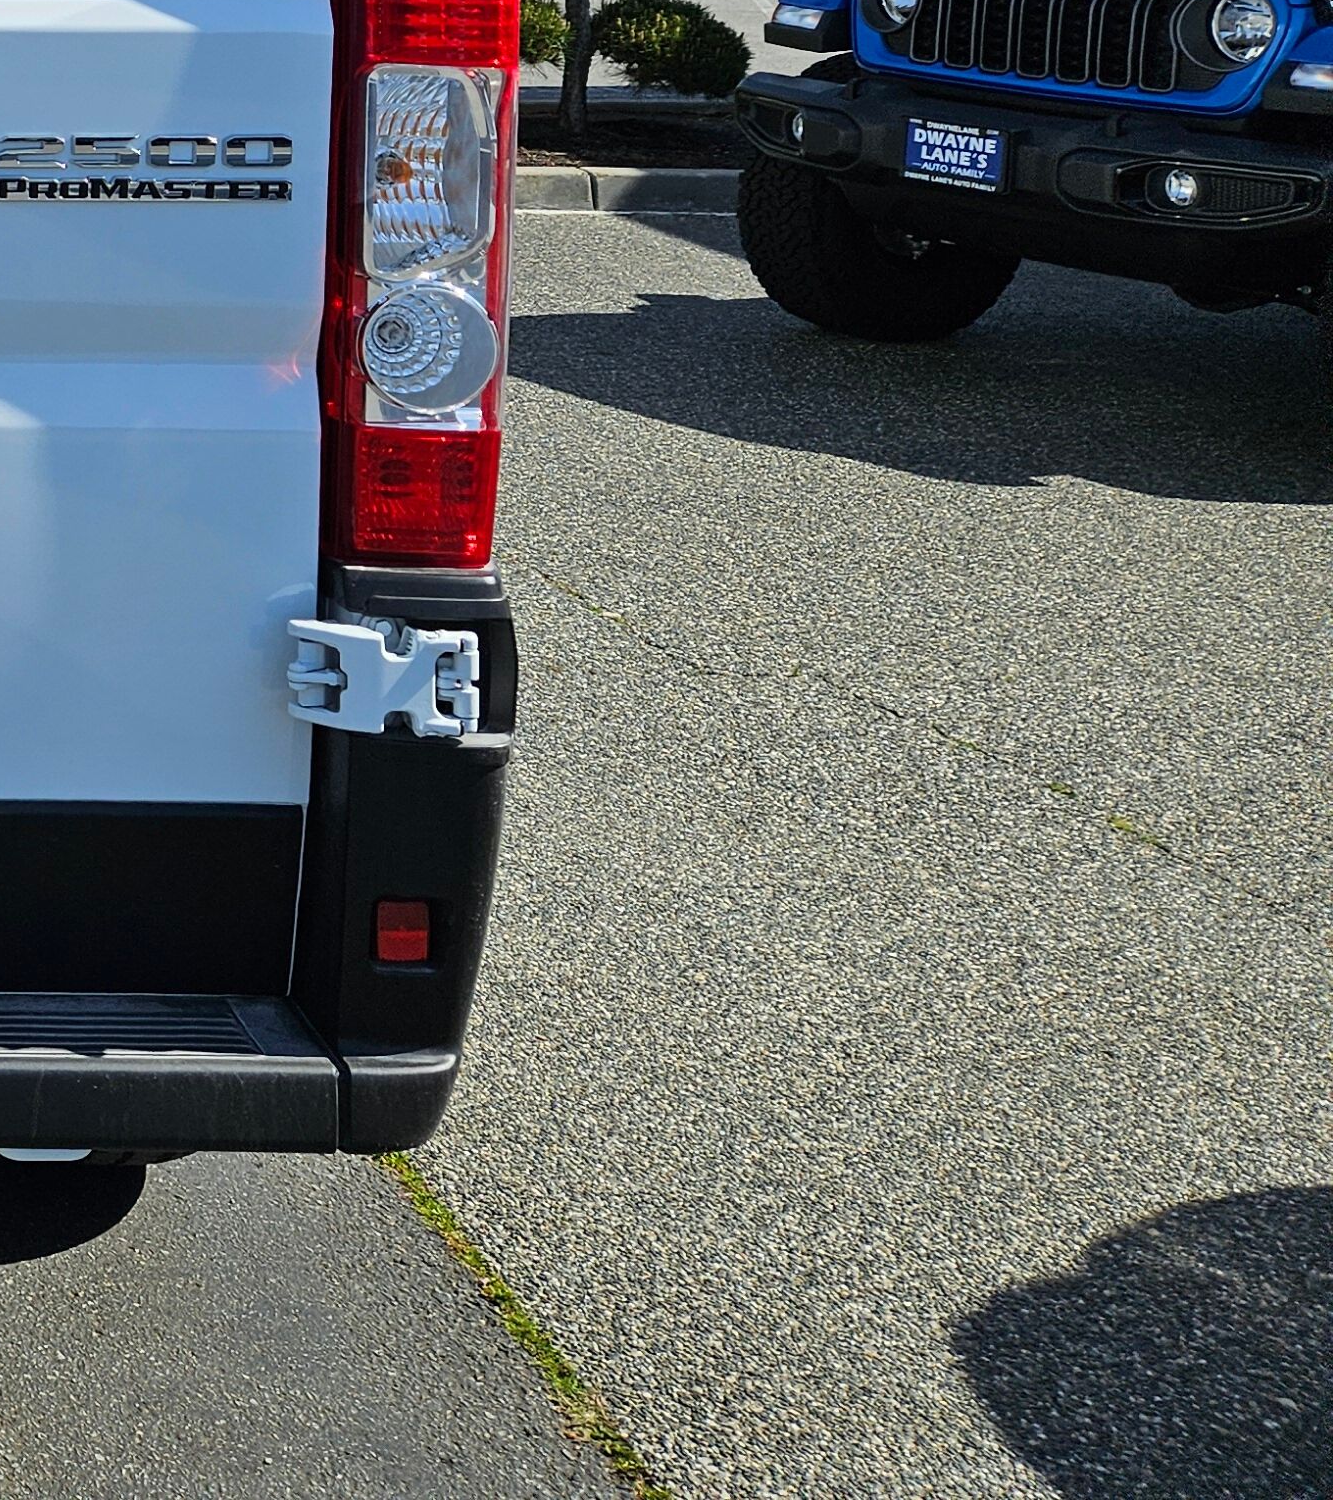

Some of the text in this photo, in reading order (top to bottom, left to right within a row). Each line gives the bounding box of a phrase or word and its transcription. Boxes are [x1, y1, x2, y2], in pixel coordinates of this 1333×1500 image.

[913, 128, 998, 154] DWAYNE
[920, 145, 988, 169] LANE'S
[921, 162, 986, 179] AUTO FAMILY
